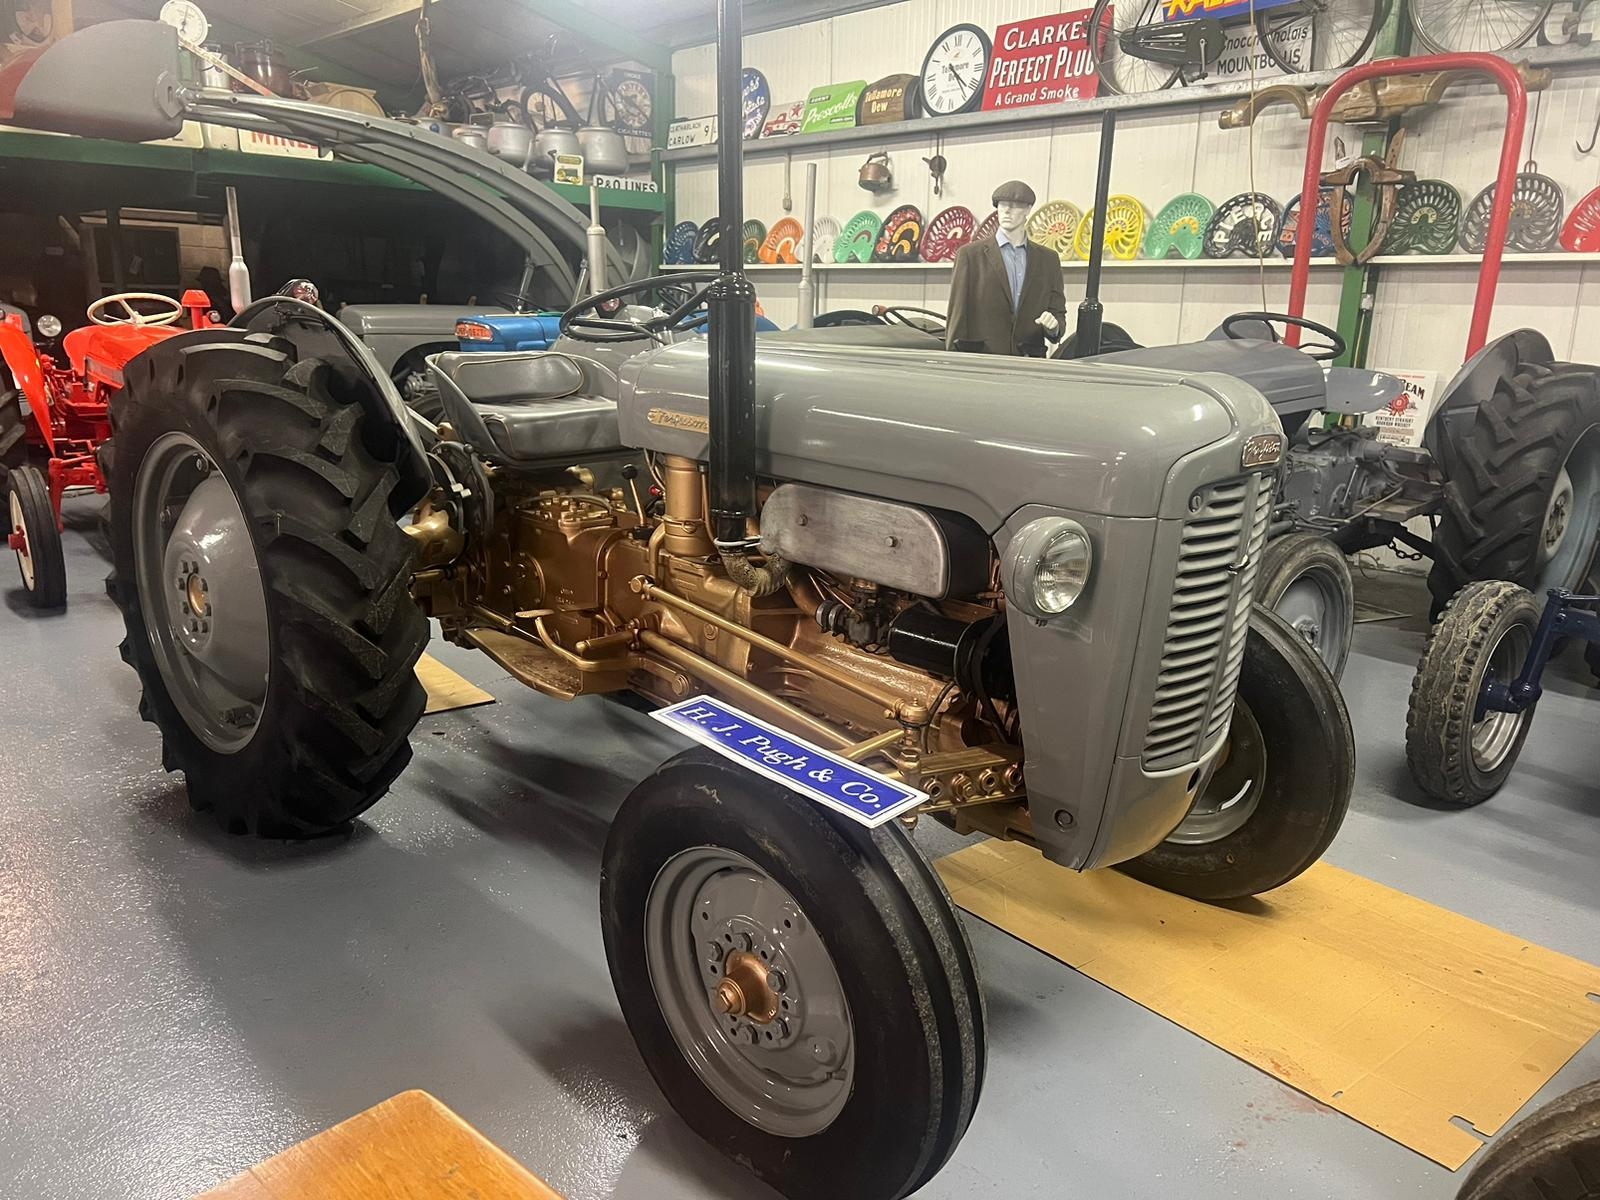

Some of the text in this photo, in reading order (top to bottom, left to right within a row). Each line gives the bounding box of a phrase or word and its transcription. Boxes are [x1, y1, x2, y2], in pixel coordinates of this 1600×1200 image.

[989, 53, 1053, 89] PERFECT
[865, 87, 903, 103] Tullamore
[995, 83, 1080, 106] A Grand Smoke
[871, 101, 888, 113] Dew
[704, 125, 710, 137] 9
[669, 134, 696, 147] CARLOW
[624, 181, 657, 193] LINES
[1402, 379, 1426, 400] EAM
[680, 706, 882, 809] H. J. Pugh & Co.
